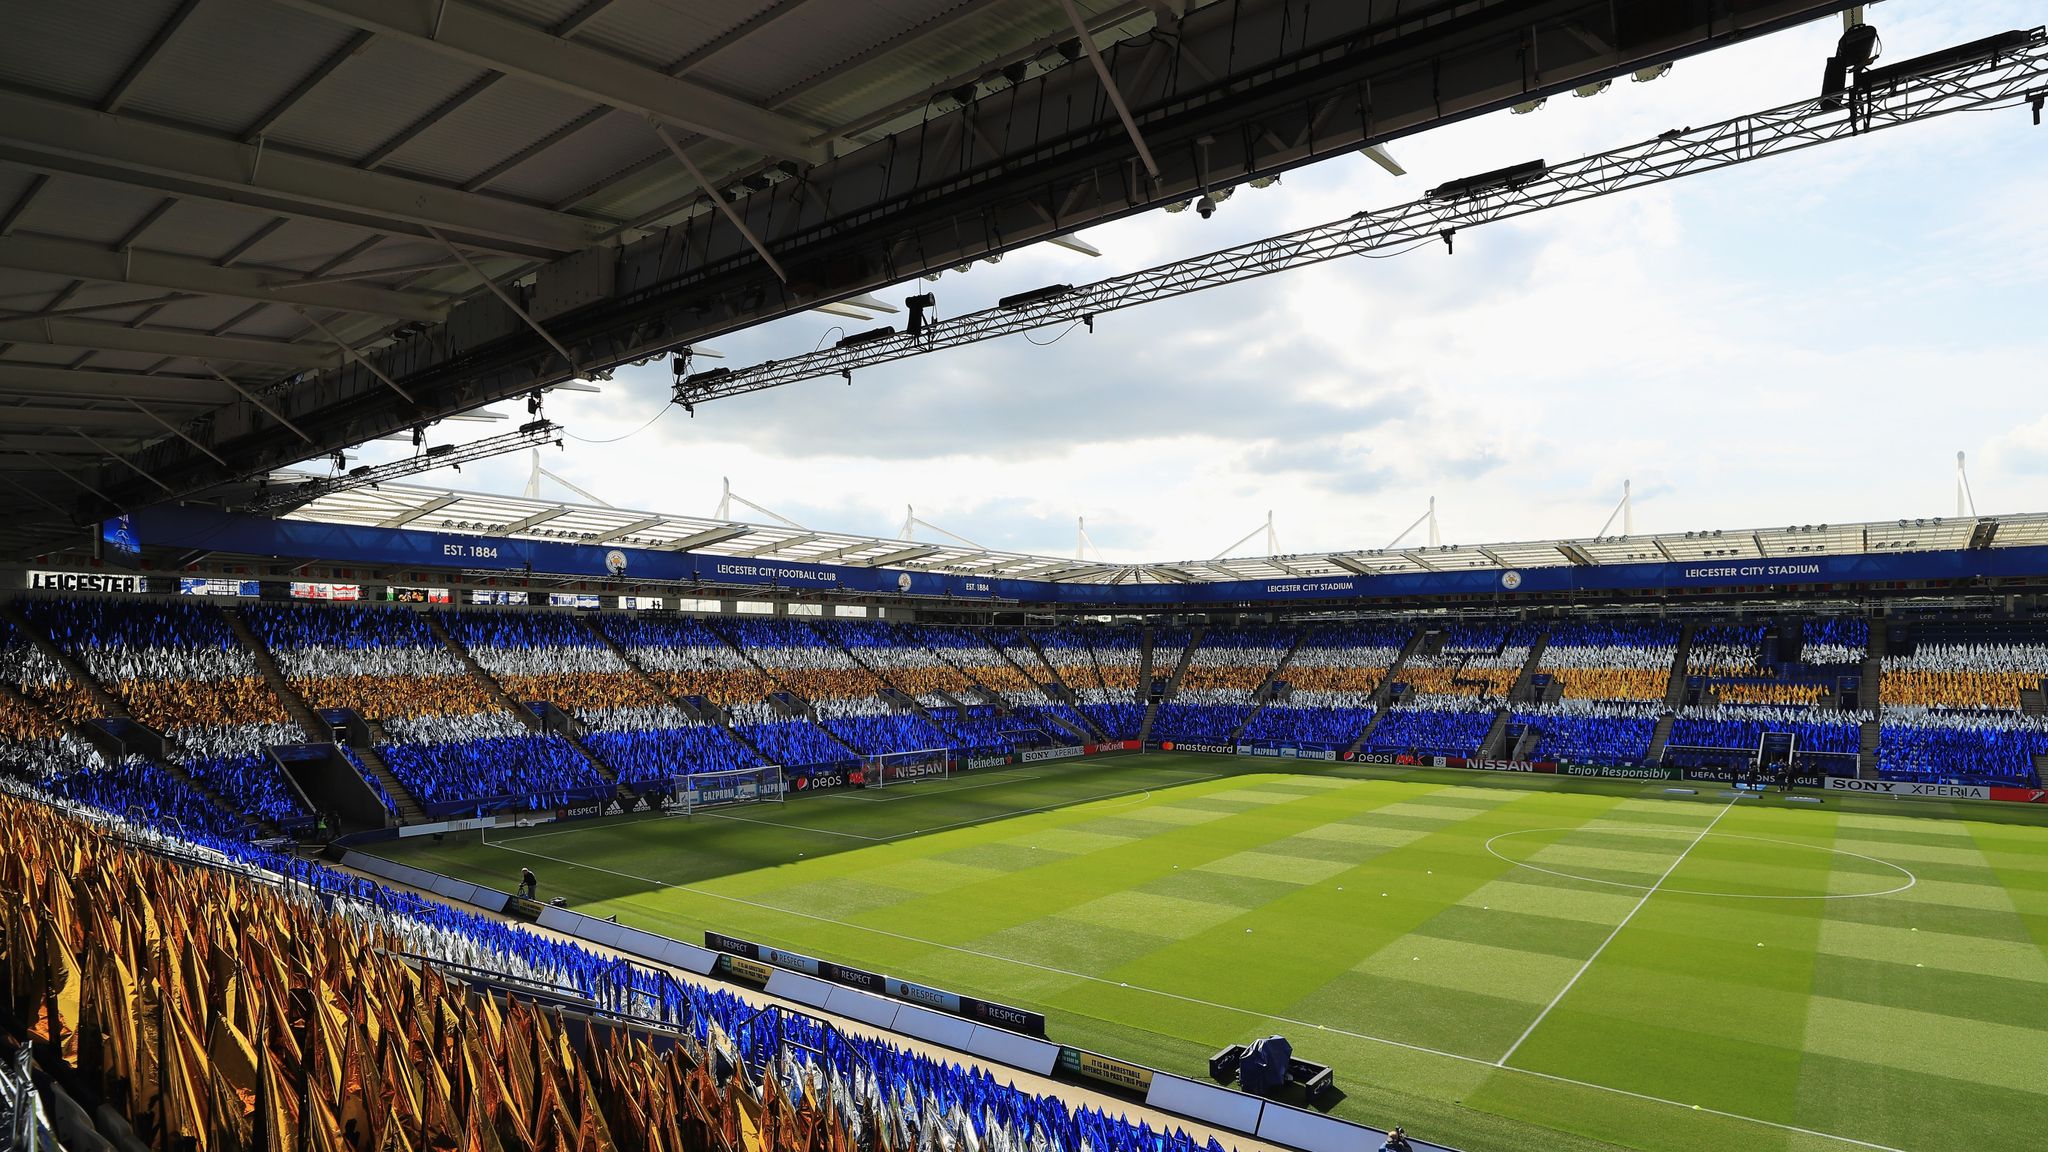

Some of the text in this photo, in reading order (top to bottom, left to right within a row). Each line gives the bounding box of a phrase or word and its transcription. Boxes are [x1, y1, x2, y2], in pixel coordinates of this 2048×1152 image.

[443, 544, 498, 558] EST. 1884
[717, 564, 837, 581] LEICESTER CITY FOOTBALL CLUB
[1685, 564, 1820, 578] LEICESTER CITY STADIUM
[32, 573, 135, 592] LEICESTER
[965, 582, 989, 592] EST. 1884
[1267, 582, 1354, 593] LEICESTER CITY STADIUM
[1025, 746, 1078, 761] SONY XPERIA
[1099, 741, 1125, 752] UniCredit
[1175, 741, 1233, 754] mastercard
[1253, 747, 1279, 756] GAZPROM
[1298, 750, 1325, 759] GAZPROM
[1358, 752, 1392, 764] pepsi
[895, 762, 943, 778] NISSAN
[967, 756, 1005, 770] Heineken
[1466, 758, 1533, 772] NISSAN
[1567, 765, 1671, 780] Enjoy Responsibly
[1690, 771, 1715, 779] UEFA
[1717, 772, 1776, 782] CHMONS
[812, 775, 842, 790] peps
[1832, 779, 1982, 798] SONY XPERIA
[703, 788, 735, 801] GAZPROM
[567, 805, 599, 817] RESPECT
[604, 808, 624, 816] adidas
[632, 804, 651, 813] adidas
[723, 939, 748, 952] RESPECT
[779, 954, 806, 968] RESPECT
[841, 970, 872, 986] RESPECT
[911, 987, 944, 1004] RESPECT
[988, 1006, 1027, 1025] RESPECT
[1103, 1069, 1110, 1077] TO
[1110, 1071, 1123, 1081] PASS
[1123, 1075, 1135, 1085] THIS
[1110, 1064, 1141, 1078] ARRESTABLE
